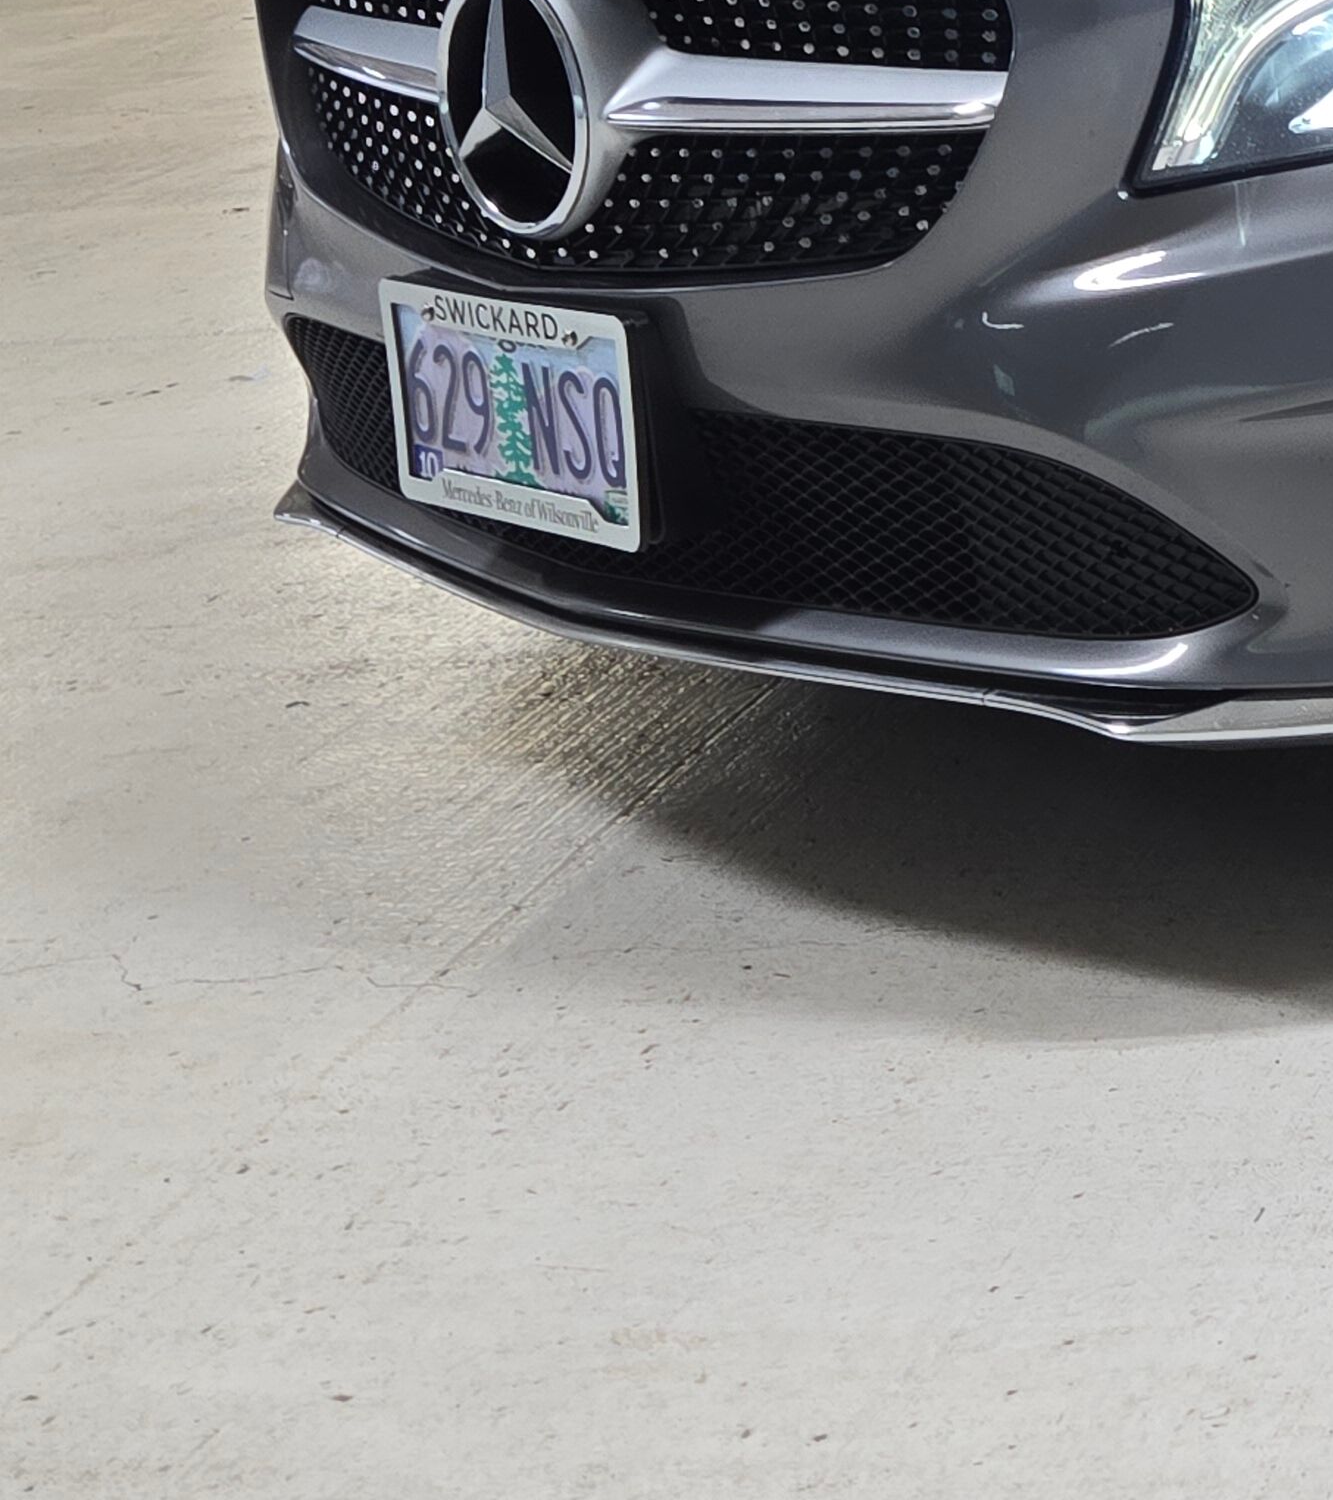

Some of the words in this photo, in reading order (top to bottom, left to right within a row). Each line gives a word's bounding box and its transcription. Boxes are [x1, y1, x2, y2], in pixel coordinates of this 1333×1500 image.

[433, 294, 559, 341] SWICKARD
[408, 337, 491, 455] 629
[521, 361, 628, 489] NSQ
